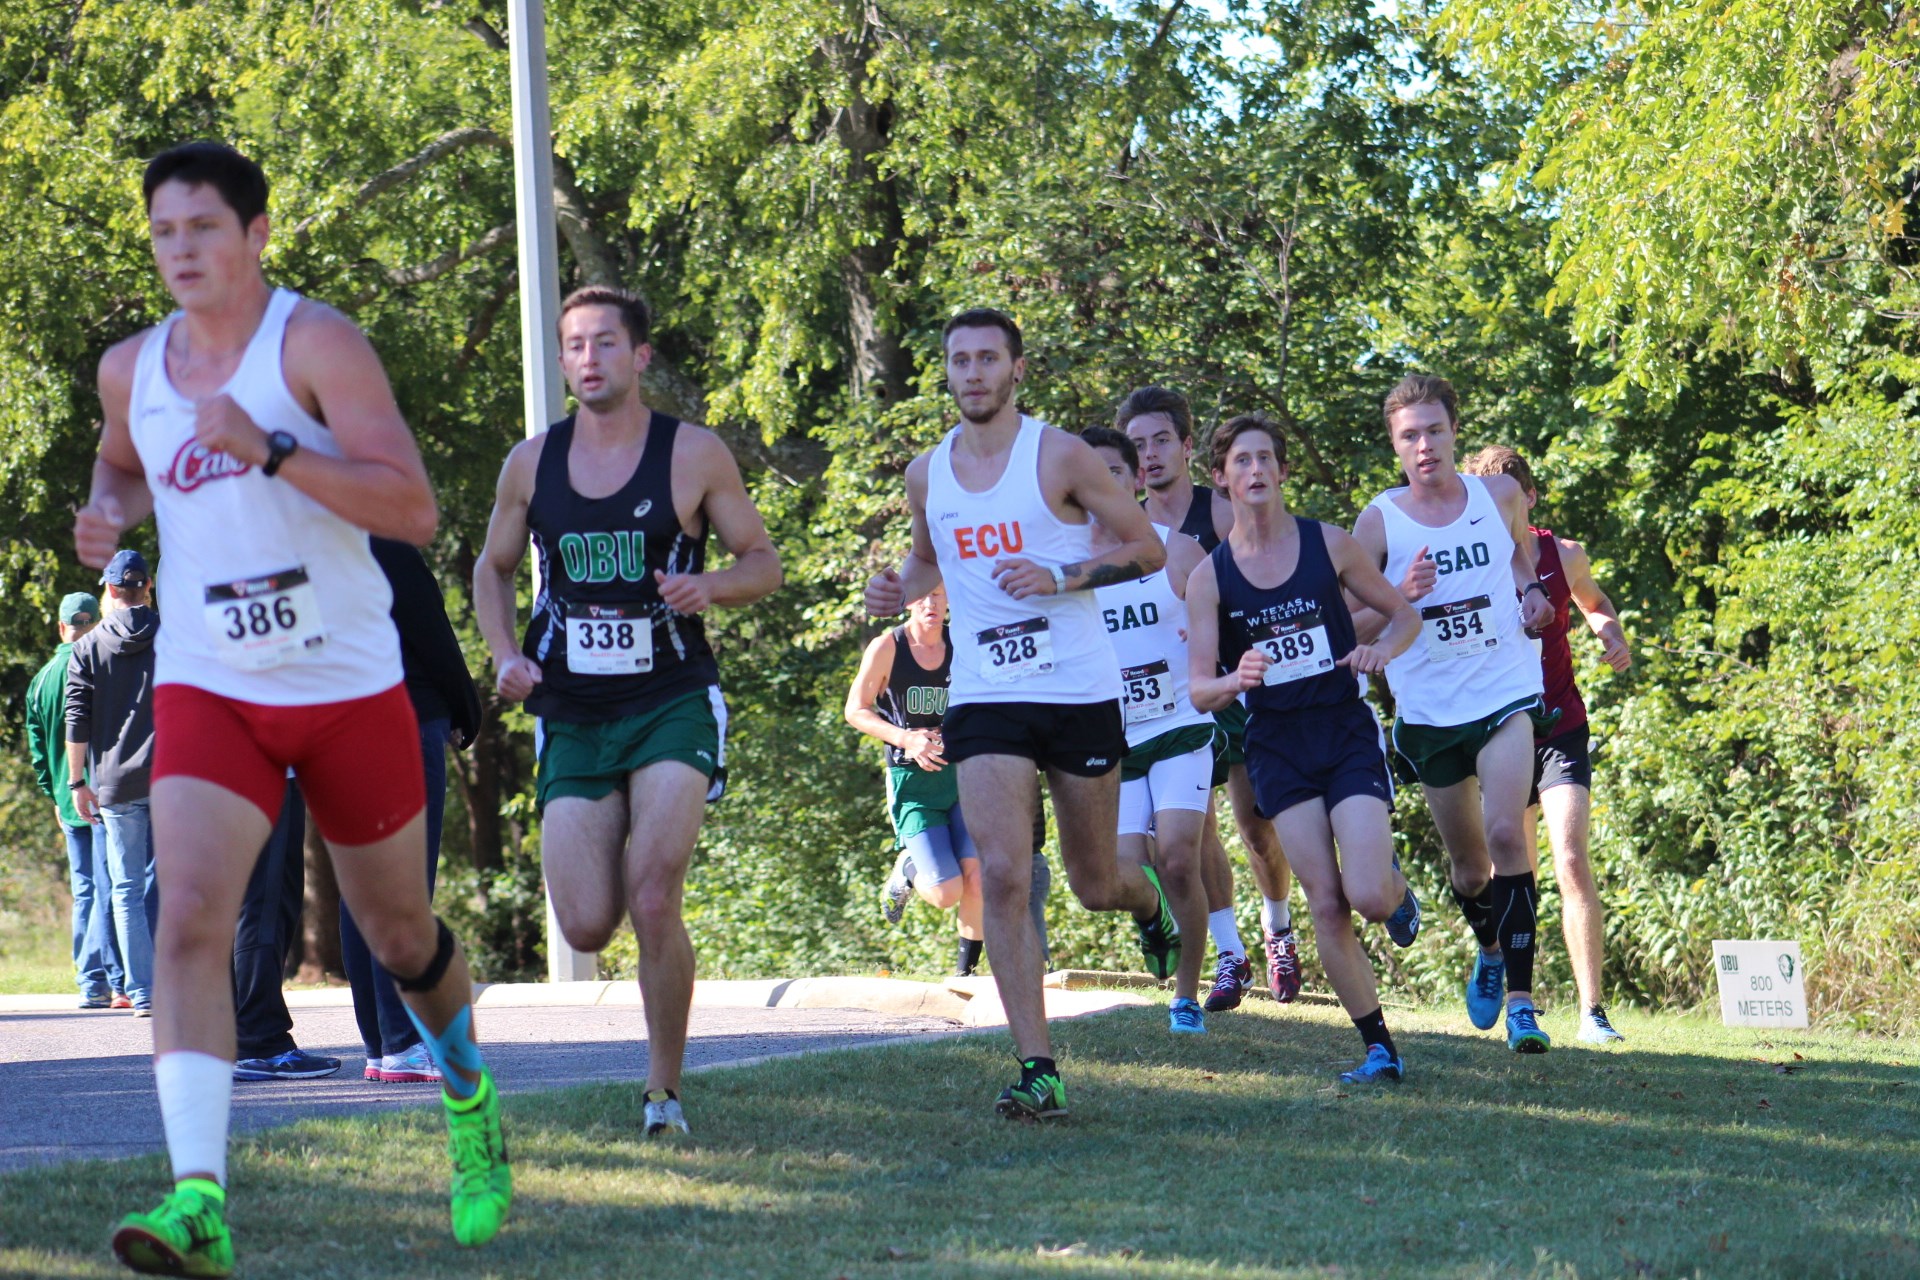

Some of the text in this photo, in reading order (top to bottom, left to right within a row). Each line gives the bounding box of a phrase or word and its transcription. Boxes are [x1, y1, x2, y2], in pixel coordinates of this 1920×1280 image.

[953, 521, 1023, 560] ECU
[559, 531, 645, 583] OBU
[1425, 542, 1490, 576] SAO
[224, 596, 297, 640] 386
[1247, 600, 1316, 628] WESLEYAN
[1260, 598, 1303, 617] TEXAS
[579, 622, 635, 650] 338
[1436, 611, 1484, 641] 354
[989, 636, 1037, 667] 328
[1265, 632, 1314, 664] 389
[1720, 954, 1738, 971] OBU
[1750, 976, 1773, 991] 800
[1738, 1000, 1793, 1017] METERS
